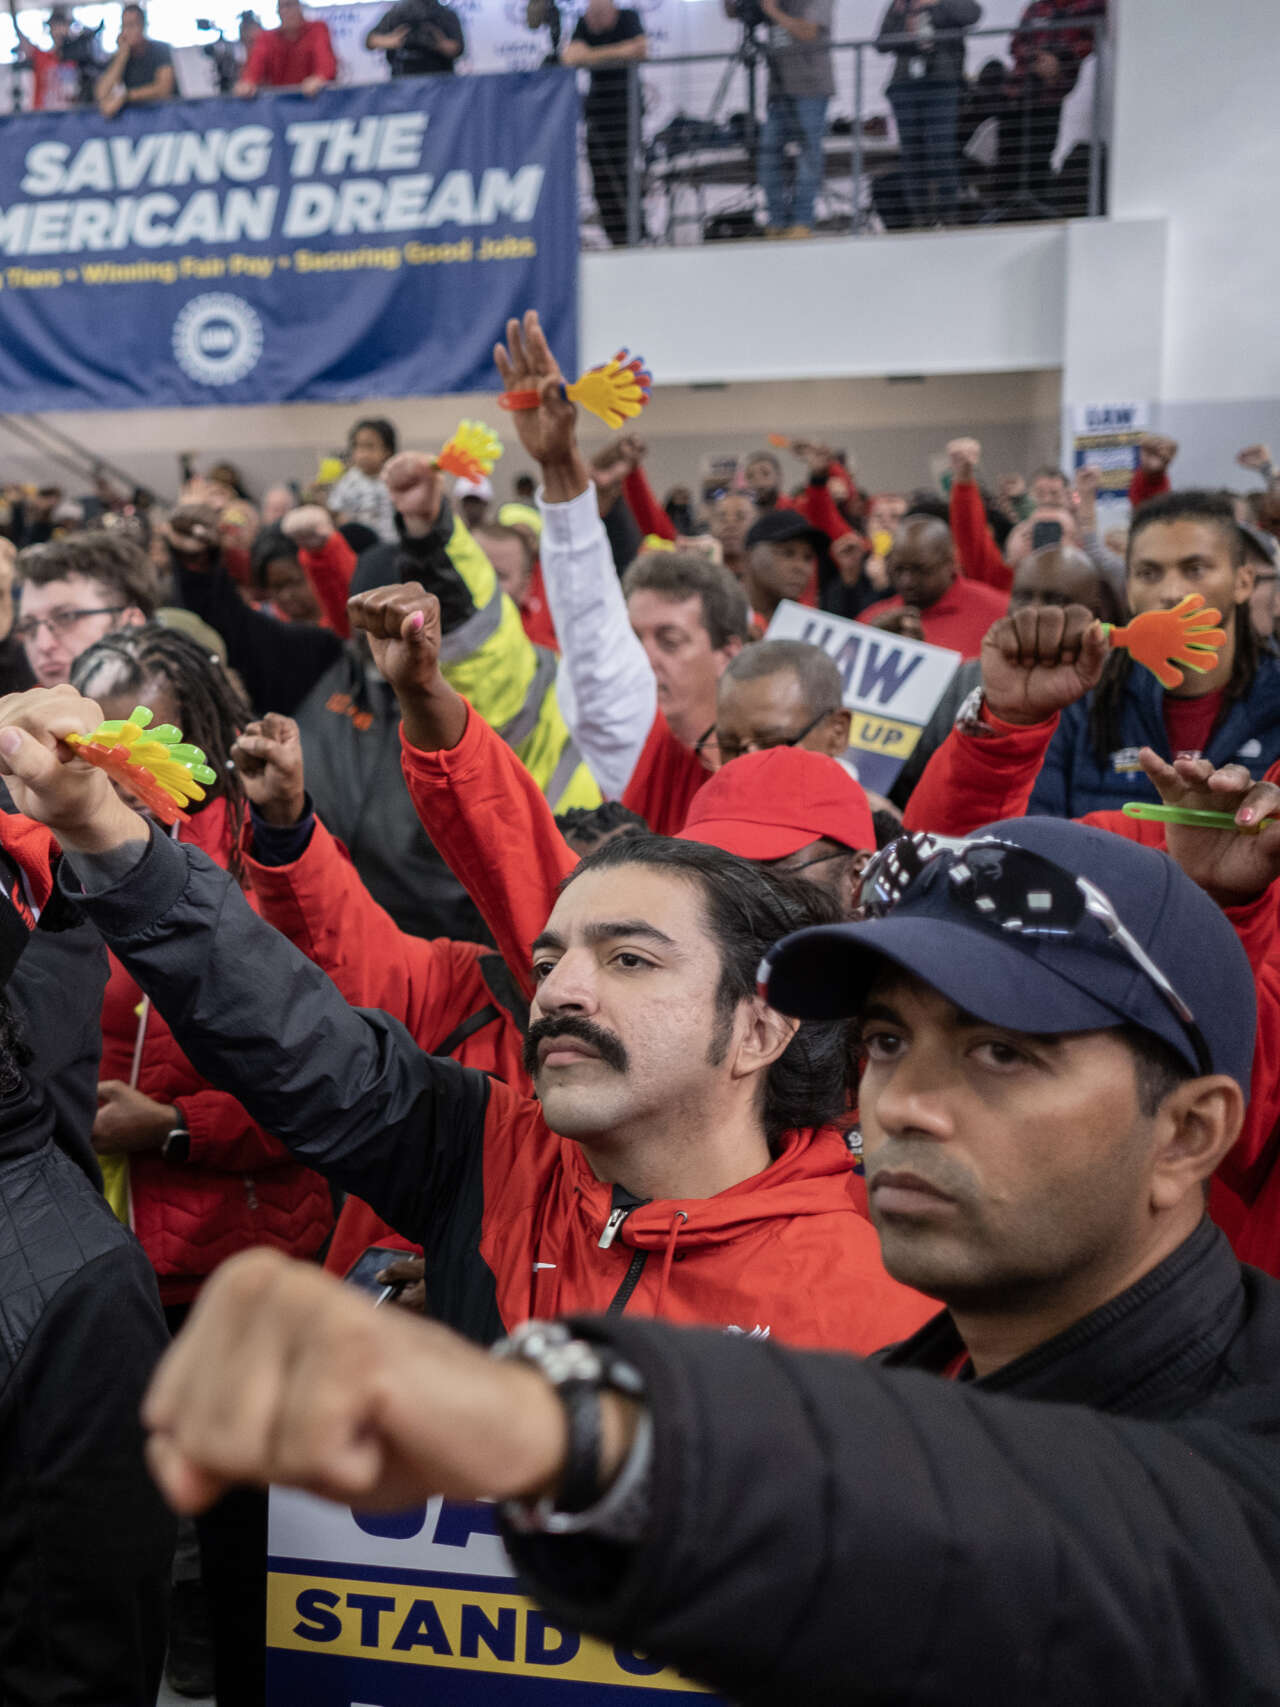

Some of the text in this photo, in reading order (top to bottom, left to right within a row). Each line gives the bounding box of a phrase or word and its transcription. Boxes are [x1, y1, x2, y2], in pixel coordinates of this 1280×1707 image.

[20, 110, 430, 196] SAVING THE
[282, 164, 545, 238] DREAM
[6, 266, 62, 288] Tiers
[80, 260, 177, 284] Winning
[179, 255, 226, 279] Fair
[228, 253, 274, 278] Pay
[293, 247, 402, 273] Securing
[404, 237, 473, 265] Good
[477, 234, 536, 260] Jobs
[861, 722, 903, 747] UP
[293, 1588, 582, 1666] STAND
